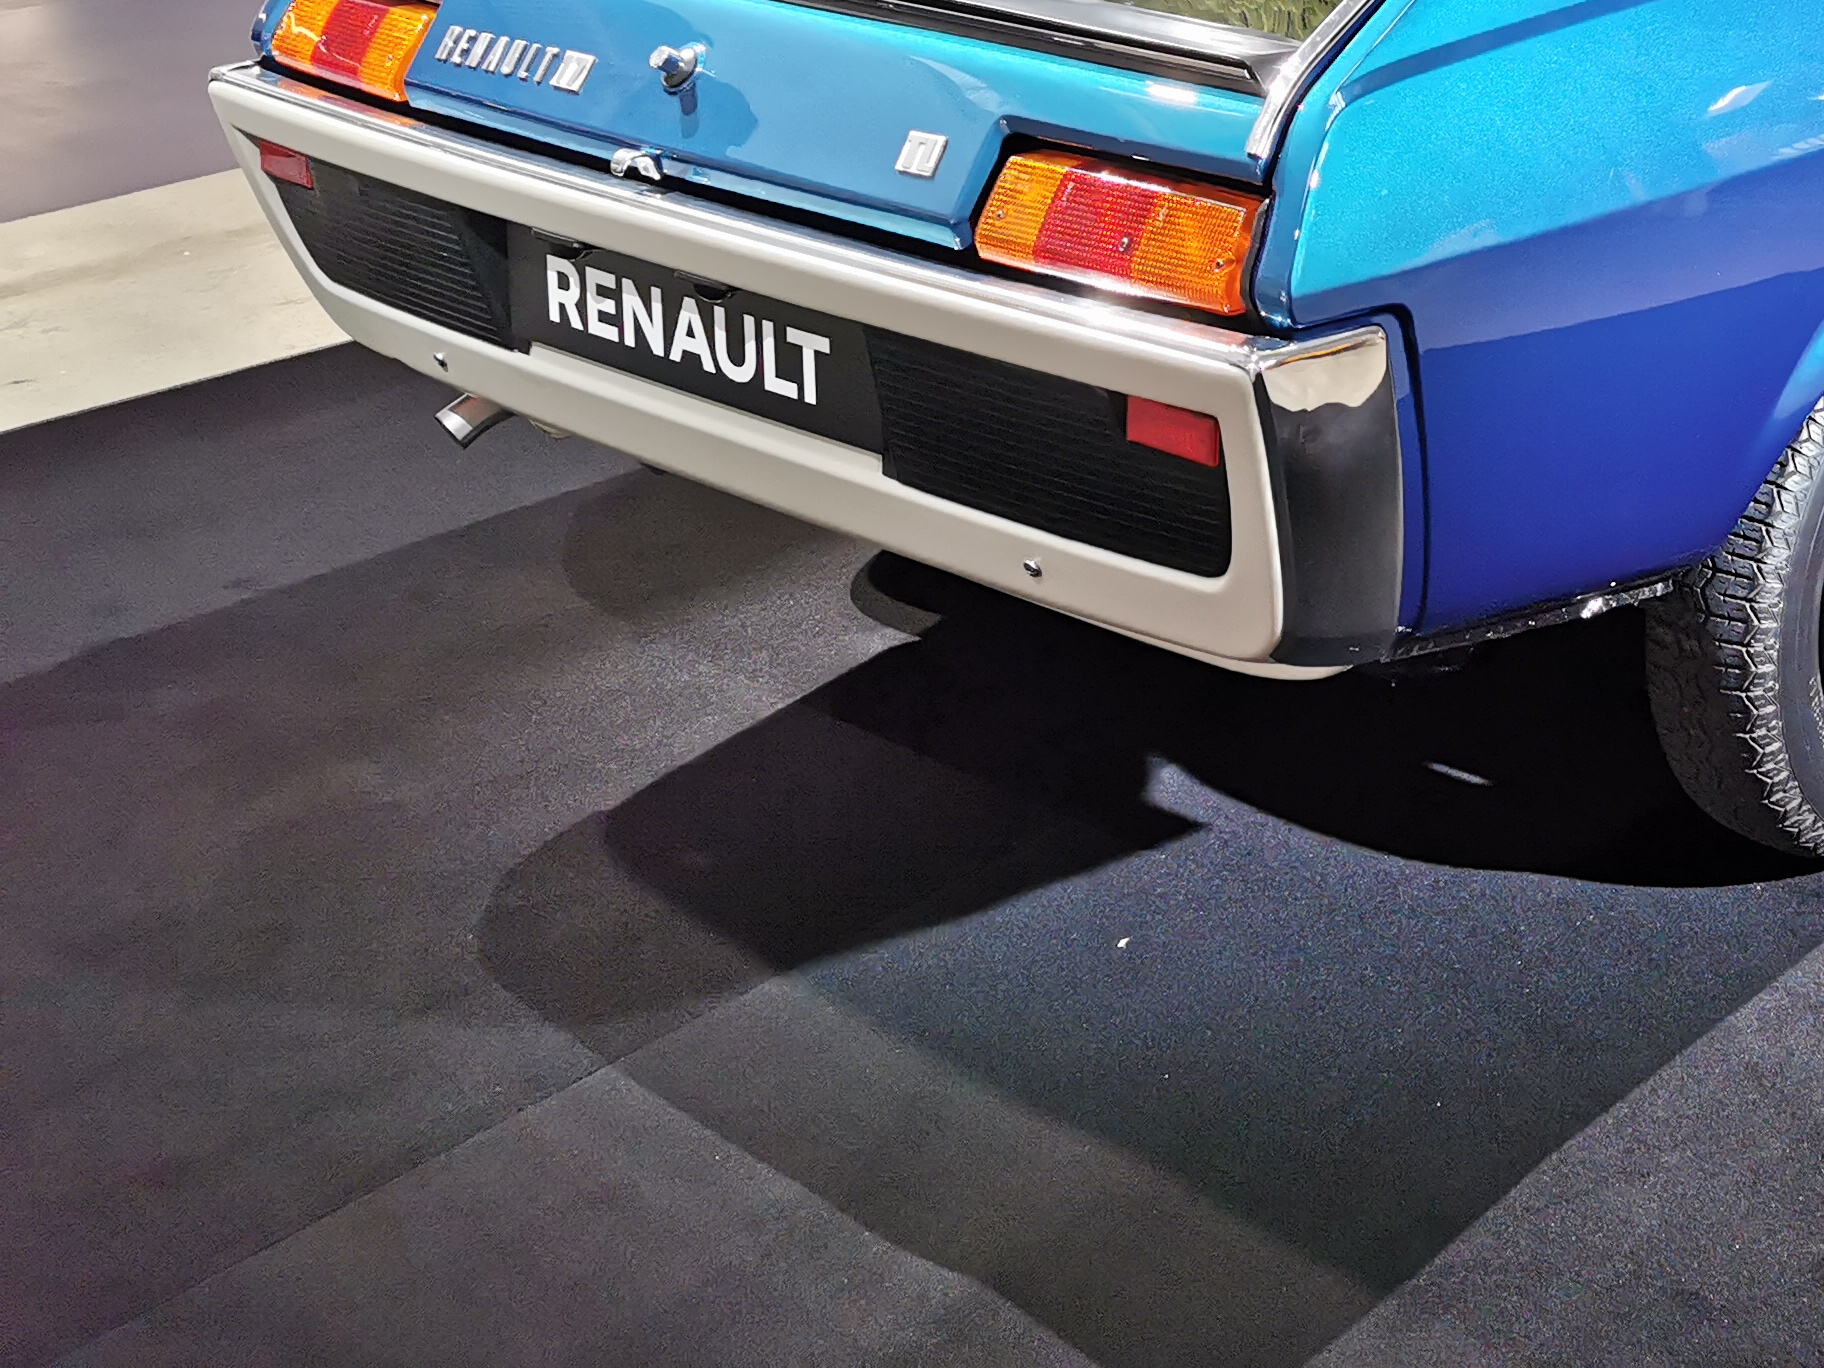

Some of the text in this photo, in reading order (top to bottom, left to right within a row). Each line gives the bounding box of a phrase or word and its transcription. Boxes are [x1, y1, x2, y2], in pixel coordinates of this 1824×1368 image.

[434, 25, 598, 95] RENAULT 17
[546, 254, 831, 406] RENAULT
